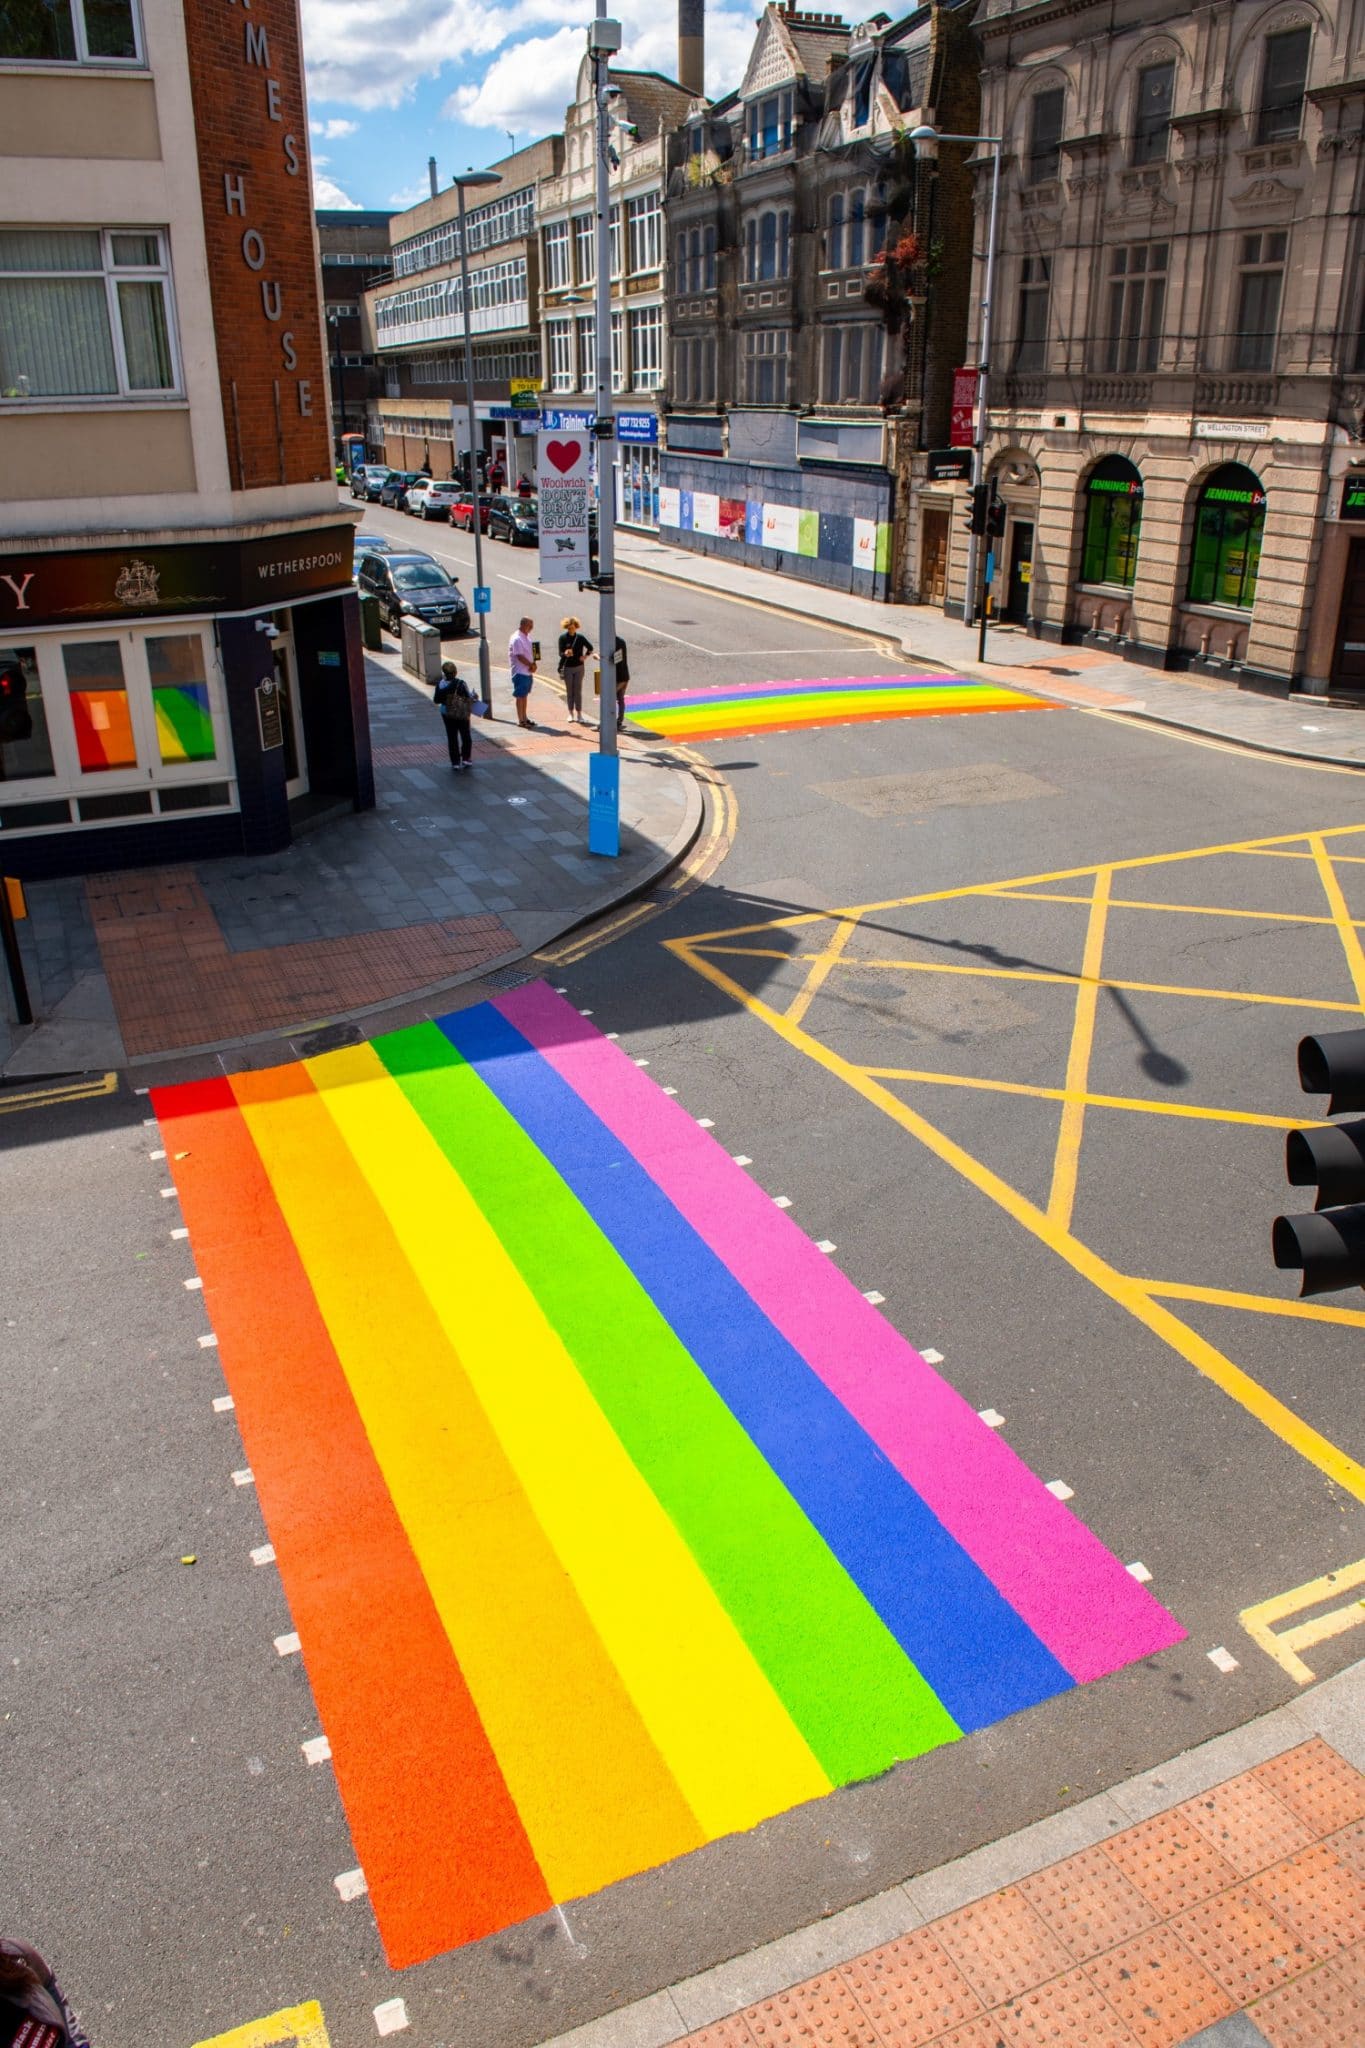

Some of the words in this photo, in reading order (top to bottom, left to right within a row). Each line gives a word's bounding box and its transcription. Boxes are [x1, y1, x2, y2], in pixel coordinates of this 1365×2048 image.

[229, 0, 299, 176] MES
[224, 173, 313, 417] HOUSE
[1207, 423, 1243, 432] WELLINGTON
[1243, 425, 1266, 433] STREET
[541, 478, 586, 488] Woolwich
[541, 489, 587, 502] DON'T
[541, 501, 586, 514] DROP
[542, 514, 586, 528] GUM
[258, 552, 342, 578] WETHERSPOON
[0, 573, 35, 609] Y
